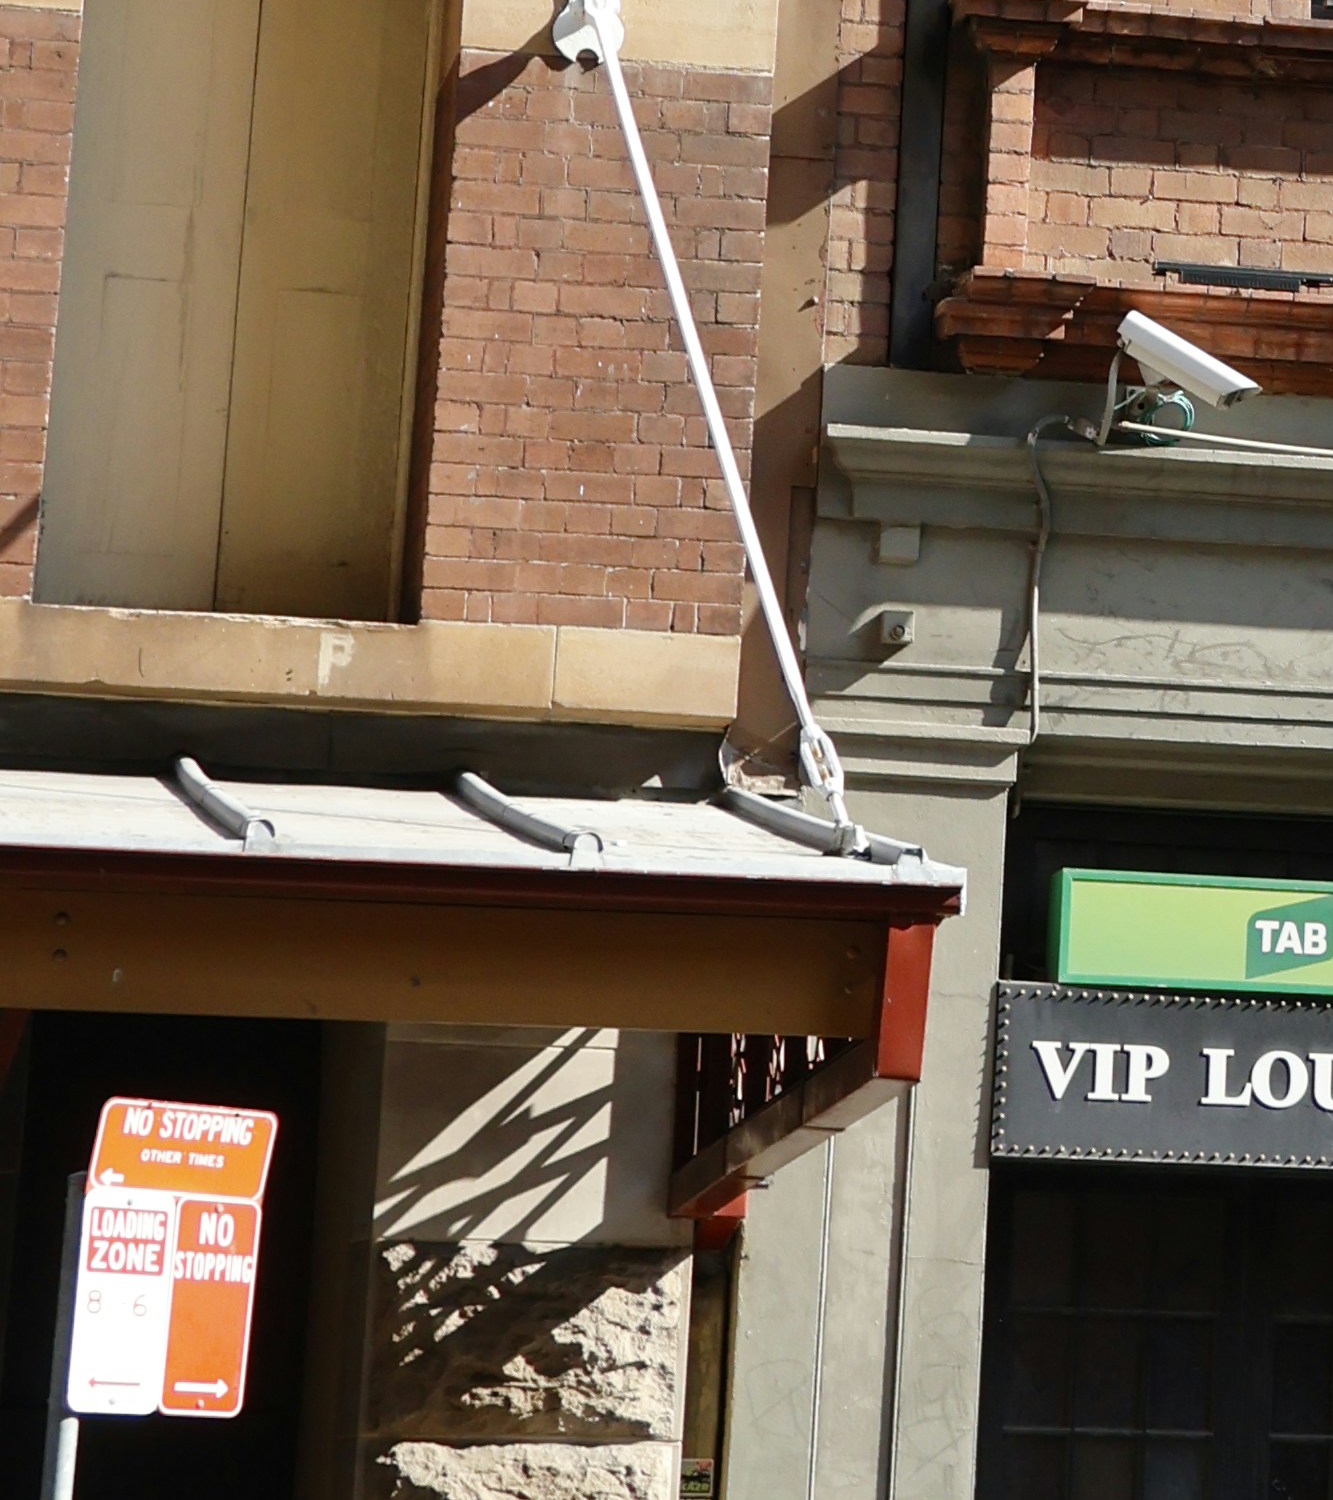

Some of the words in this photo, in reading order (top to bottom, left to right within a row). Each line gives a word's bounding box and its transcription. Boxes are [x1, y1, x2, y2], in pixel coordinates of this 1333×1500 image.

[1254, 919, 1328, 957] TAB
[1031, 1039, 1171, 1103] VIP
[123, 1107, 154, 1136] NO
[159, 1111, 254, 1146] STOPPING
[140, 1148, 182, 1165] OTHER
[188, 1153, 225, 1169] TIMES
[92, 1209, 166, 1242] LOADING
[199, 1212, 234, 1247] NO
[90, 1240, 161, 1273] ZONE
[174, 1250, 253, 1284] STOPPING
[87, 1290, 102, 1314] 8
[132, 1294, 147, 1317] 6
